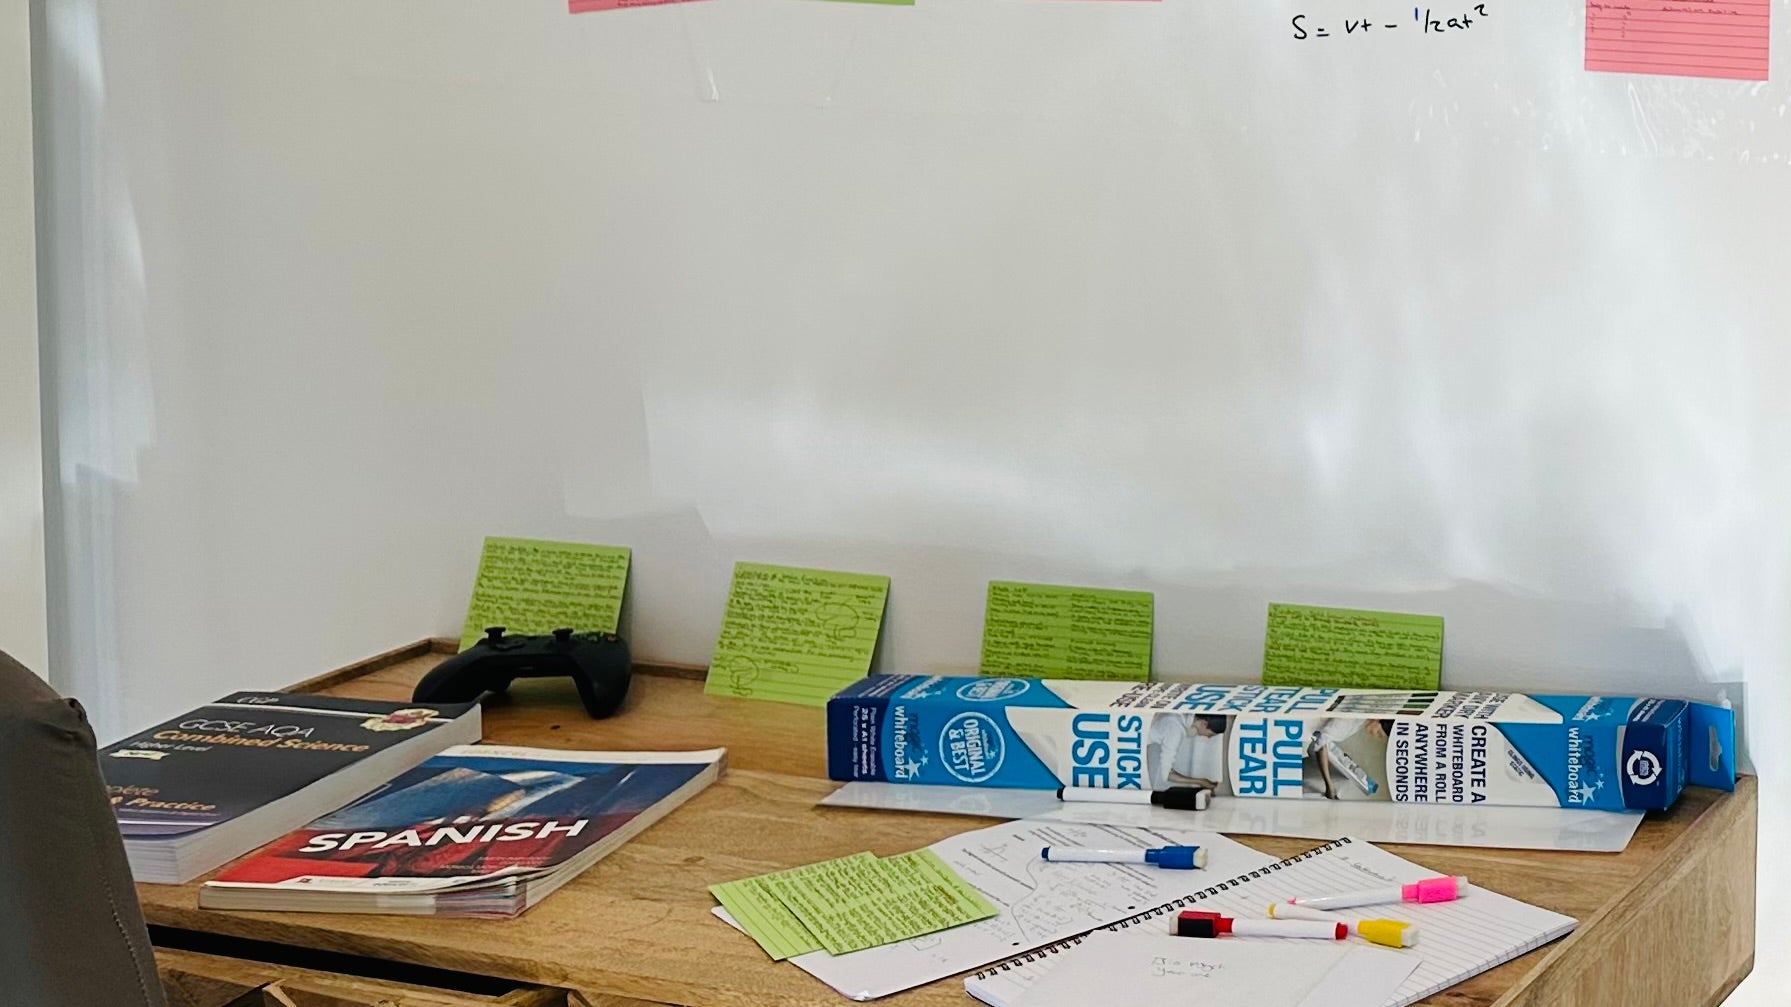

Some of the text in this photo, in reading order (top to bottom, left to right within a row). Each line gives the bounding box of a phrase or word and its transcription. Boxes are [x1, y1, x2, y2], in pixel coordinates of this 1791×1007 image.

[153, 729, 371, 753] Combined Science
[179, 718, 316, 739] GCSE AQA
[894, 705, 909, 779] whiteboard
[950, 741, 969, 771] BEST
[963, 718, 986, 776] ORIGINAL
[1071, 713, 1111, 790] USE
[1116, 714, 1142, 790] STICK
[1239, 718, 1268, 795] TEAR
[1273, 719, 1304, 797] PULL
[1395, 722, 1409, 803] IN SECONDS
[1415, 723, 1429, 803] ANYWHERE
[1435, 723, 1448, 803] FROM A ROLL
[1452, 724, 1465, 803] WHITEBOARD
[1471, 725, 1487, 803] CREATE A
[1567, 727, 1583, 803] whiteboard
[127, 795, 217, 812] Practice
[298, 818, 590, 854] SPANISH
